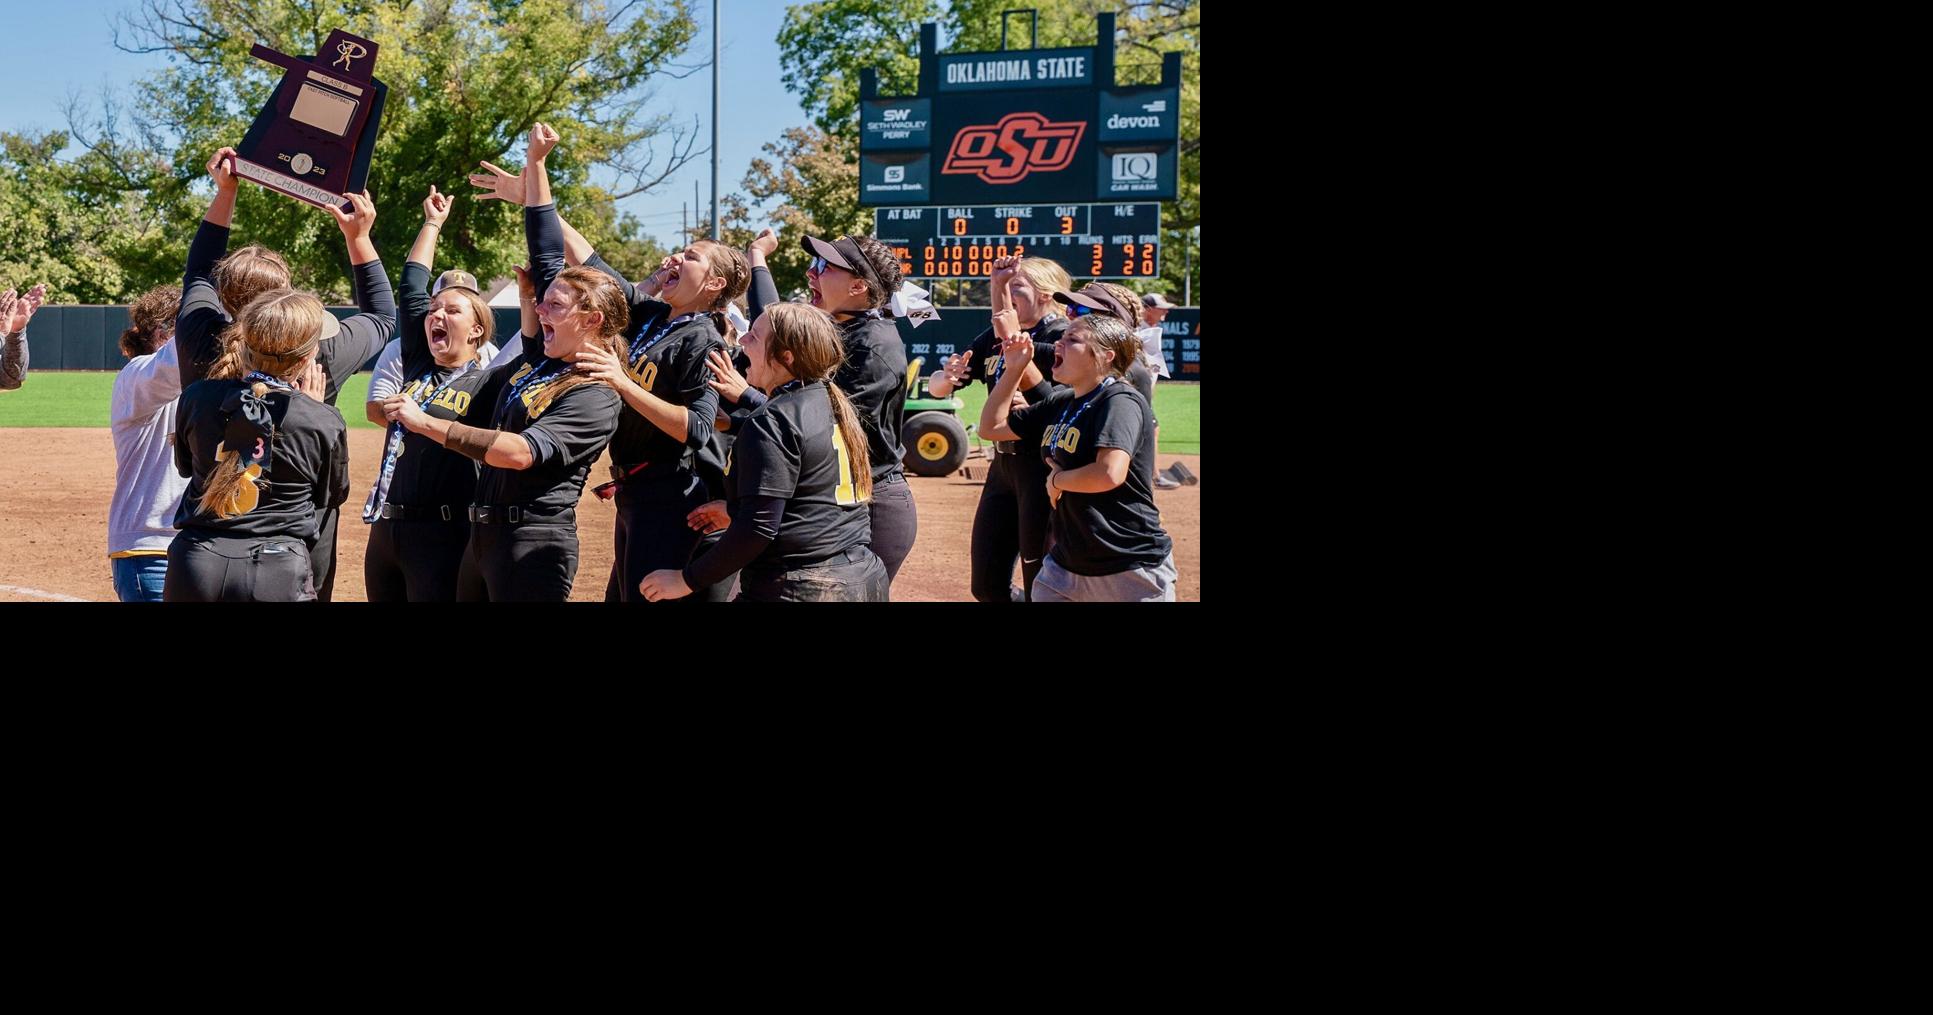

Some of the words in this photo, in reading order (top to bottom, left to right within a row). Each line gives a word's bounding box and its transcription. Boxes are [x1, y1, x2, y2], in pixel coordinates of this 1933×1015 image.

[947, 60, 1031, 84] OKLAHOMA
[1037, 57, 1085, 80] STATE
[883, 109, 911, 121] SW
[1107, 114, 1160, 129] devon
[883, 131, 910, 139] PERRY
[941, 112, 1087, 184] OSU
[278, 153, 291, 162] 20
[312, 165, 326, 175] 23
[1120, 156, 1151, 180] IQ
[242, 163, 273, 181] STATE
[275, 177, 339, 205] CHAMPION
[887, 210, 901, 220] AT
[903, 209, 922, 220] BAT
[948, 208, 974, 219] BALL
[995, 207, 1032, 218] STRIKE
[1054, 206, 1078, 217] OUT
[1114, 205, 1135, 217] H/E
[954, 218, 966, 235] 0
[1006, 217, 1019, 235] 0
[1060, 216, 1073, 235] 3
[928, 238, 933, 246] 1
[941, 238, 947, 246] 2
[1060, 237, 1071, 245] 10
[1078, 235, 1104, 244] RUNS
[1112, 235, 1134, 244] HITS
[1139, 235, 1157, 244] ERR
[924, 246, 935, 260] 0
[952, 246, 962, 260] 0
[968, 246, 979, 260] 0
[982, 246, 993, 260] 0
[996, 245, 1007, 260] 0
[1092, 244, 1103, 260] 3
[1123, 244, 1135, 258] 9
[1142, 244, 1154, 259] 2
[924, 261, 935, 276] 0
[938, 261, 948, 276] 0
[952, 261, 962, 276] 0
[968, 261, 979, 276] 0
[1091, 260, 1102, 275] 2
[1123, 260, 1134, 275] 2
[1142, 260, 1154, 275] 0
[453, 272, 466, 284] T
[252, 437, 265, 459] 3
